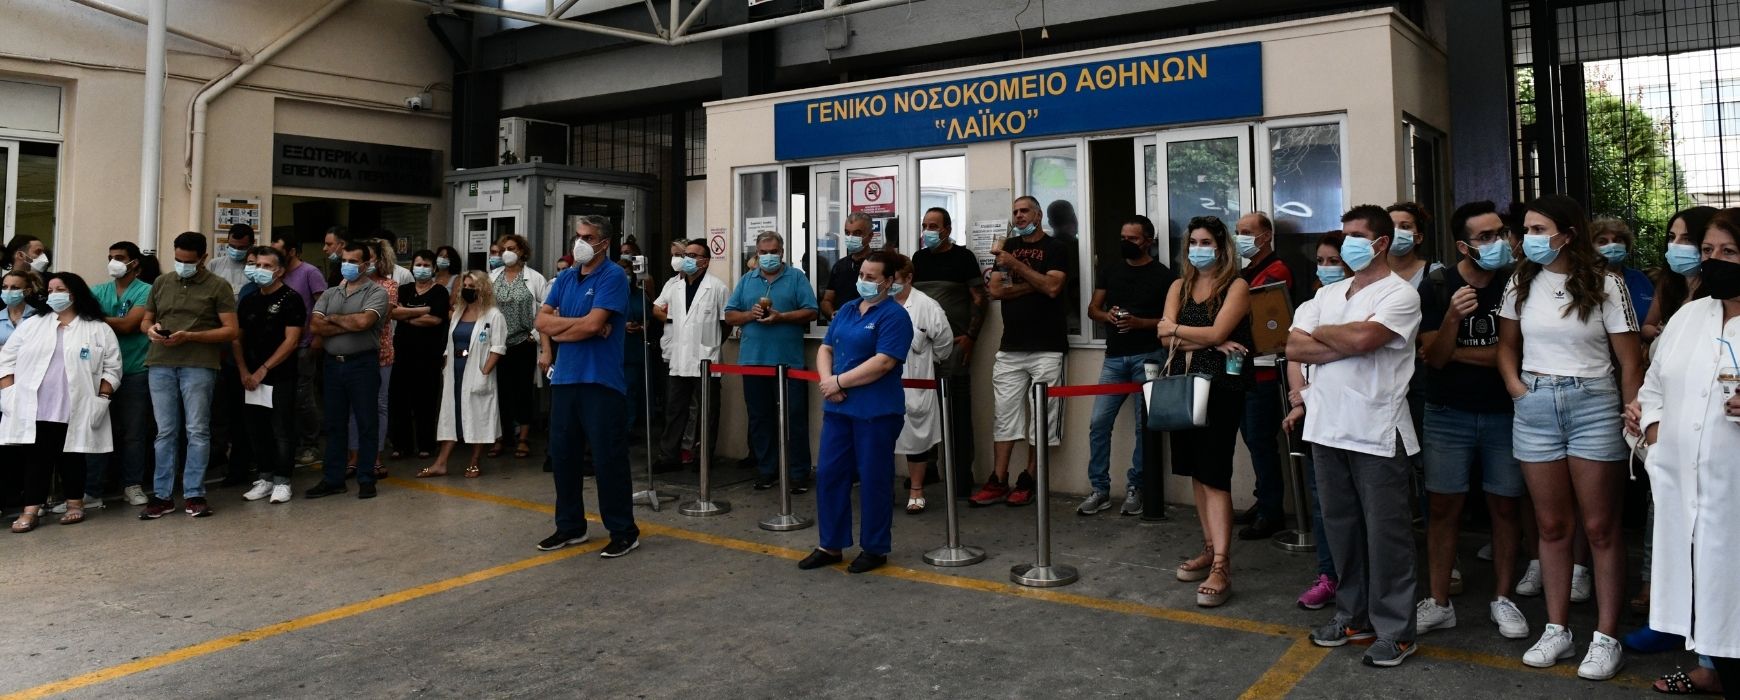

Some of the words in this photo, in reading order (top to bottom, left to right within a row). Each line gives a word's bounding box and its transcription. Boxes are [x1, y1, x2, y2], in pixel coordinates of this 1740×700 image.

[807, 95, 887, 123] ΓΕΝΙΚΟ
[894, 71, 1067, 113] ΝΟΣΟΚΟΜΕΙΟ
[1075, 54, 1208, 92] ΑΘΗΝΩΝ
[282, 144, 369, 165] ΕΞΩΤΕΡΙΚΑ
[281, 163, 352, 180] ΕΠΕΙΓΟΝΤΑ
[1480, 338, 1486, 346] &
